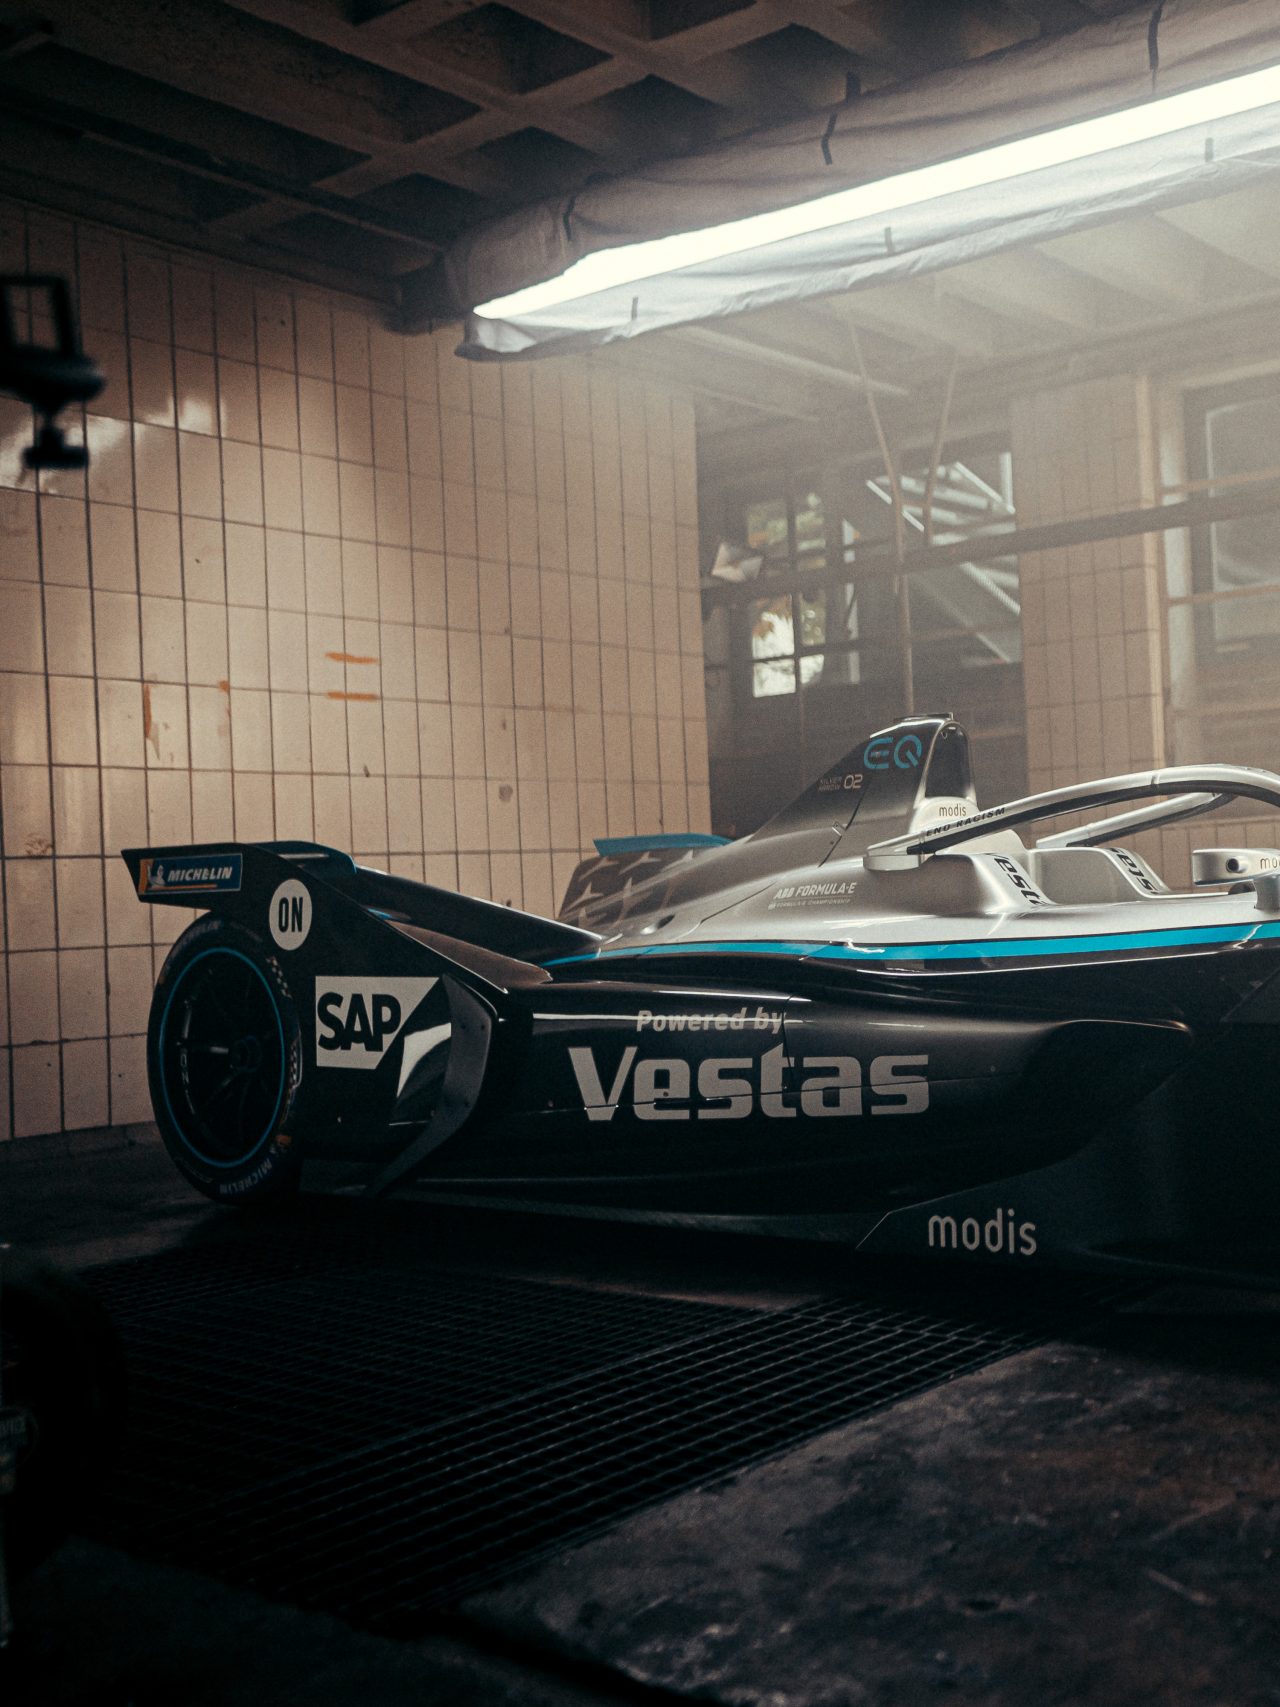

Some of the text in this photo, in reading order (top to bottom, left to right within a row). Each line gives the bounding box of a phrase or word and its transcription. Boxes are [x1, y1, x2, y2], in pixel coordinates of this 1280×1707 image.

[863, 735, 922, 769] EQ
[843, 774, 863, 789] 02
[926, 807, 1006, 837] END RACISM
[938, 803, 967, 817] modis
[167, 866, 233, 882] MICHELIN
[278, 896, 303, 933] ON
[317, 991, 402, 1052] SAP
[636, 1007, 785, 1034] Powered by
[568, 1042, 929, 1121] Vestas
[928, 1208, 1038, 1256] modis
